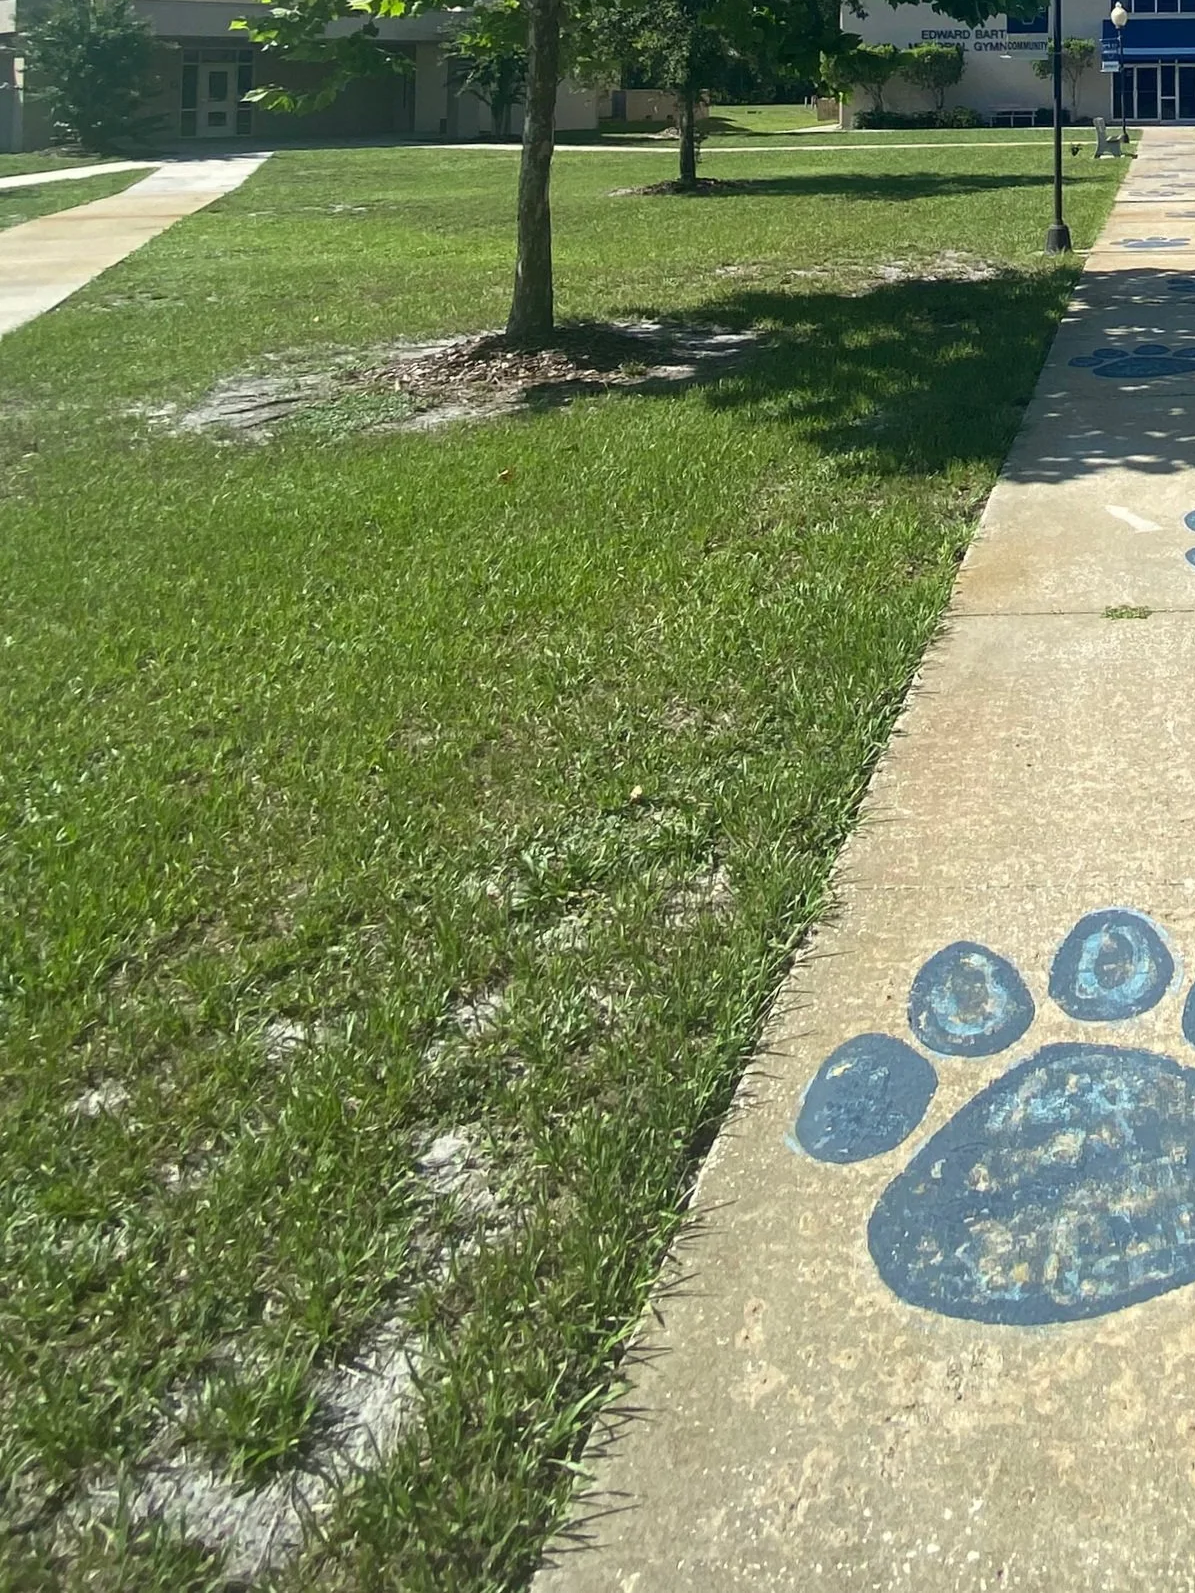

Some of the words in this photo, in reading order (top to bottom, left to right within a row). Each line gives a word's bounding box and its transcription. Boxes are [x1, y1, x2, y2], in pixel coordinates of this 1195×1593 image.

[921, 29, 971, 40] EDWARD
[975, 29, 1006, 40] BART
[974, 41, 1007, 52] GYMN
[1008, 41, 1048, 51] COMMUNITY
